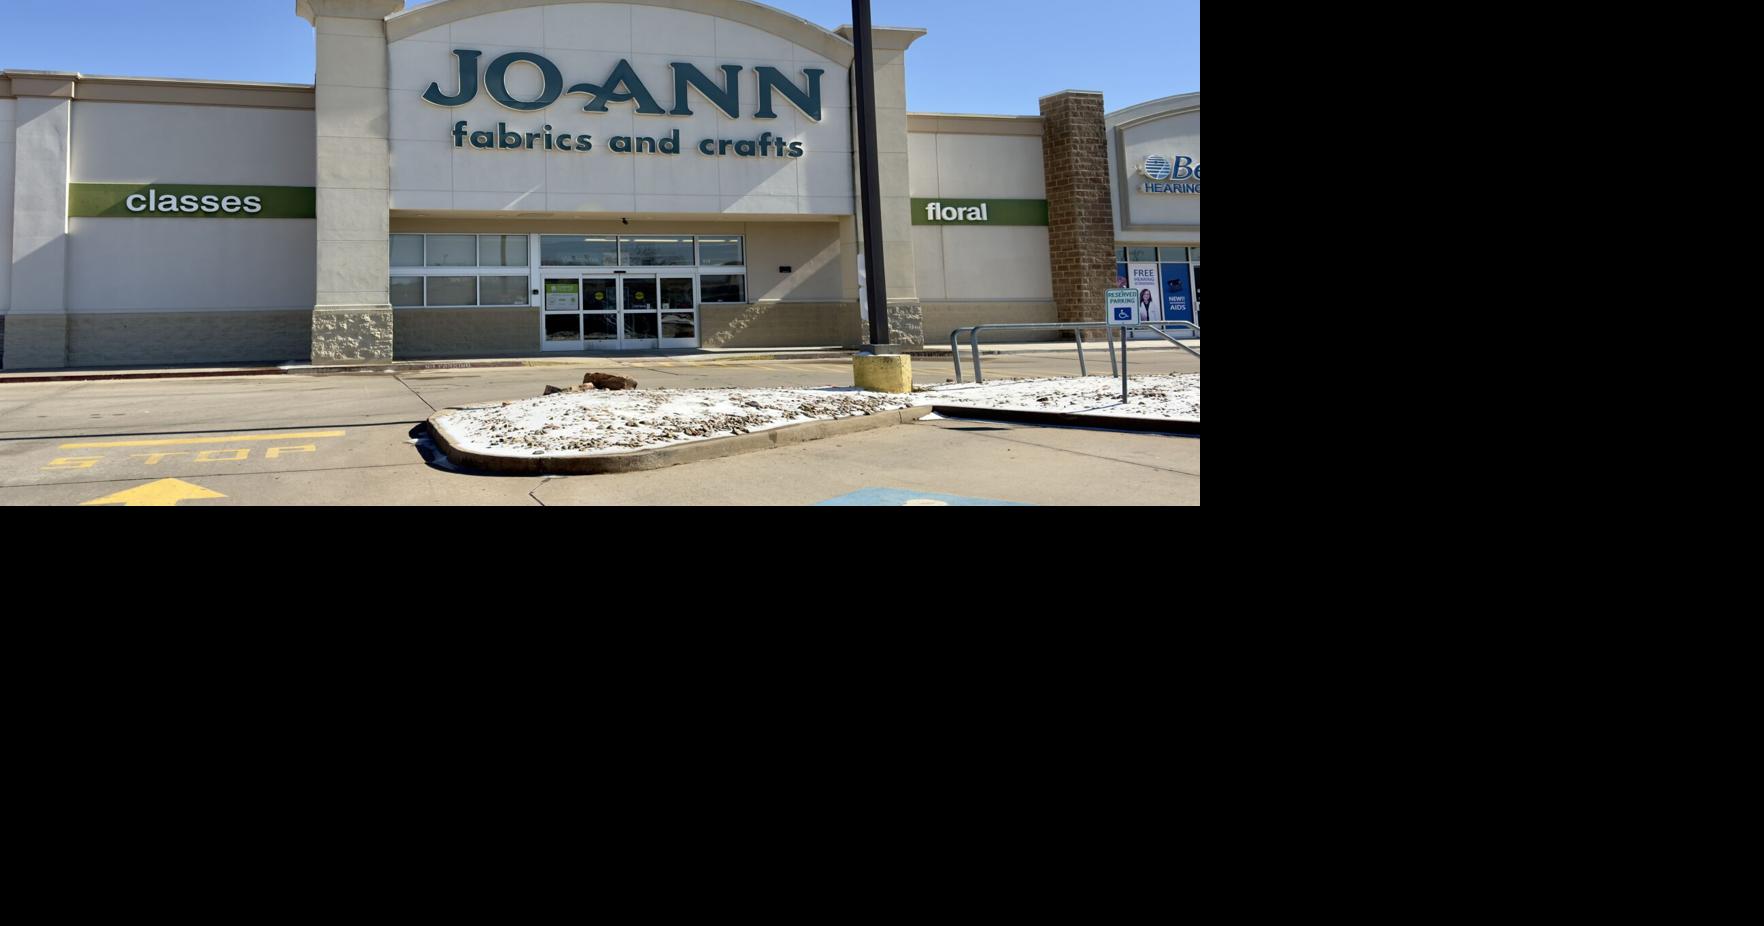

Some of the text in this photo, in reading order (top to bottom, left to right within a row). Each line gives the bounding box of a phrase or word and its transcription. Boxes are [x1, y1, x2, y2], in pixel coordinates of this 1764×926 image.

[451, 120, 805, 158] fabrics and crafts
[125, 189, 263, 213] classes
[925, 202, 988, 221] floral
[1133, 269, 1155, 277] FREE
[40, 445, 316, 471] STOP
